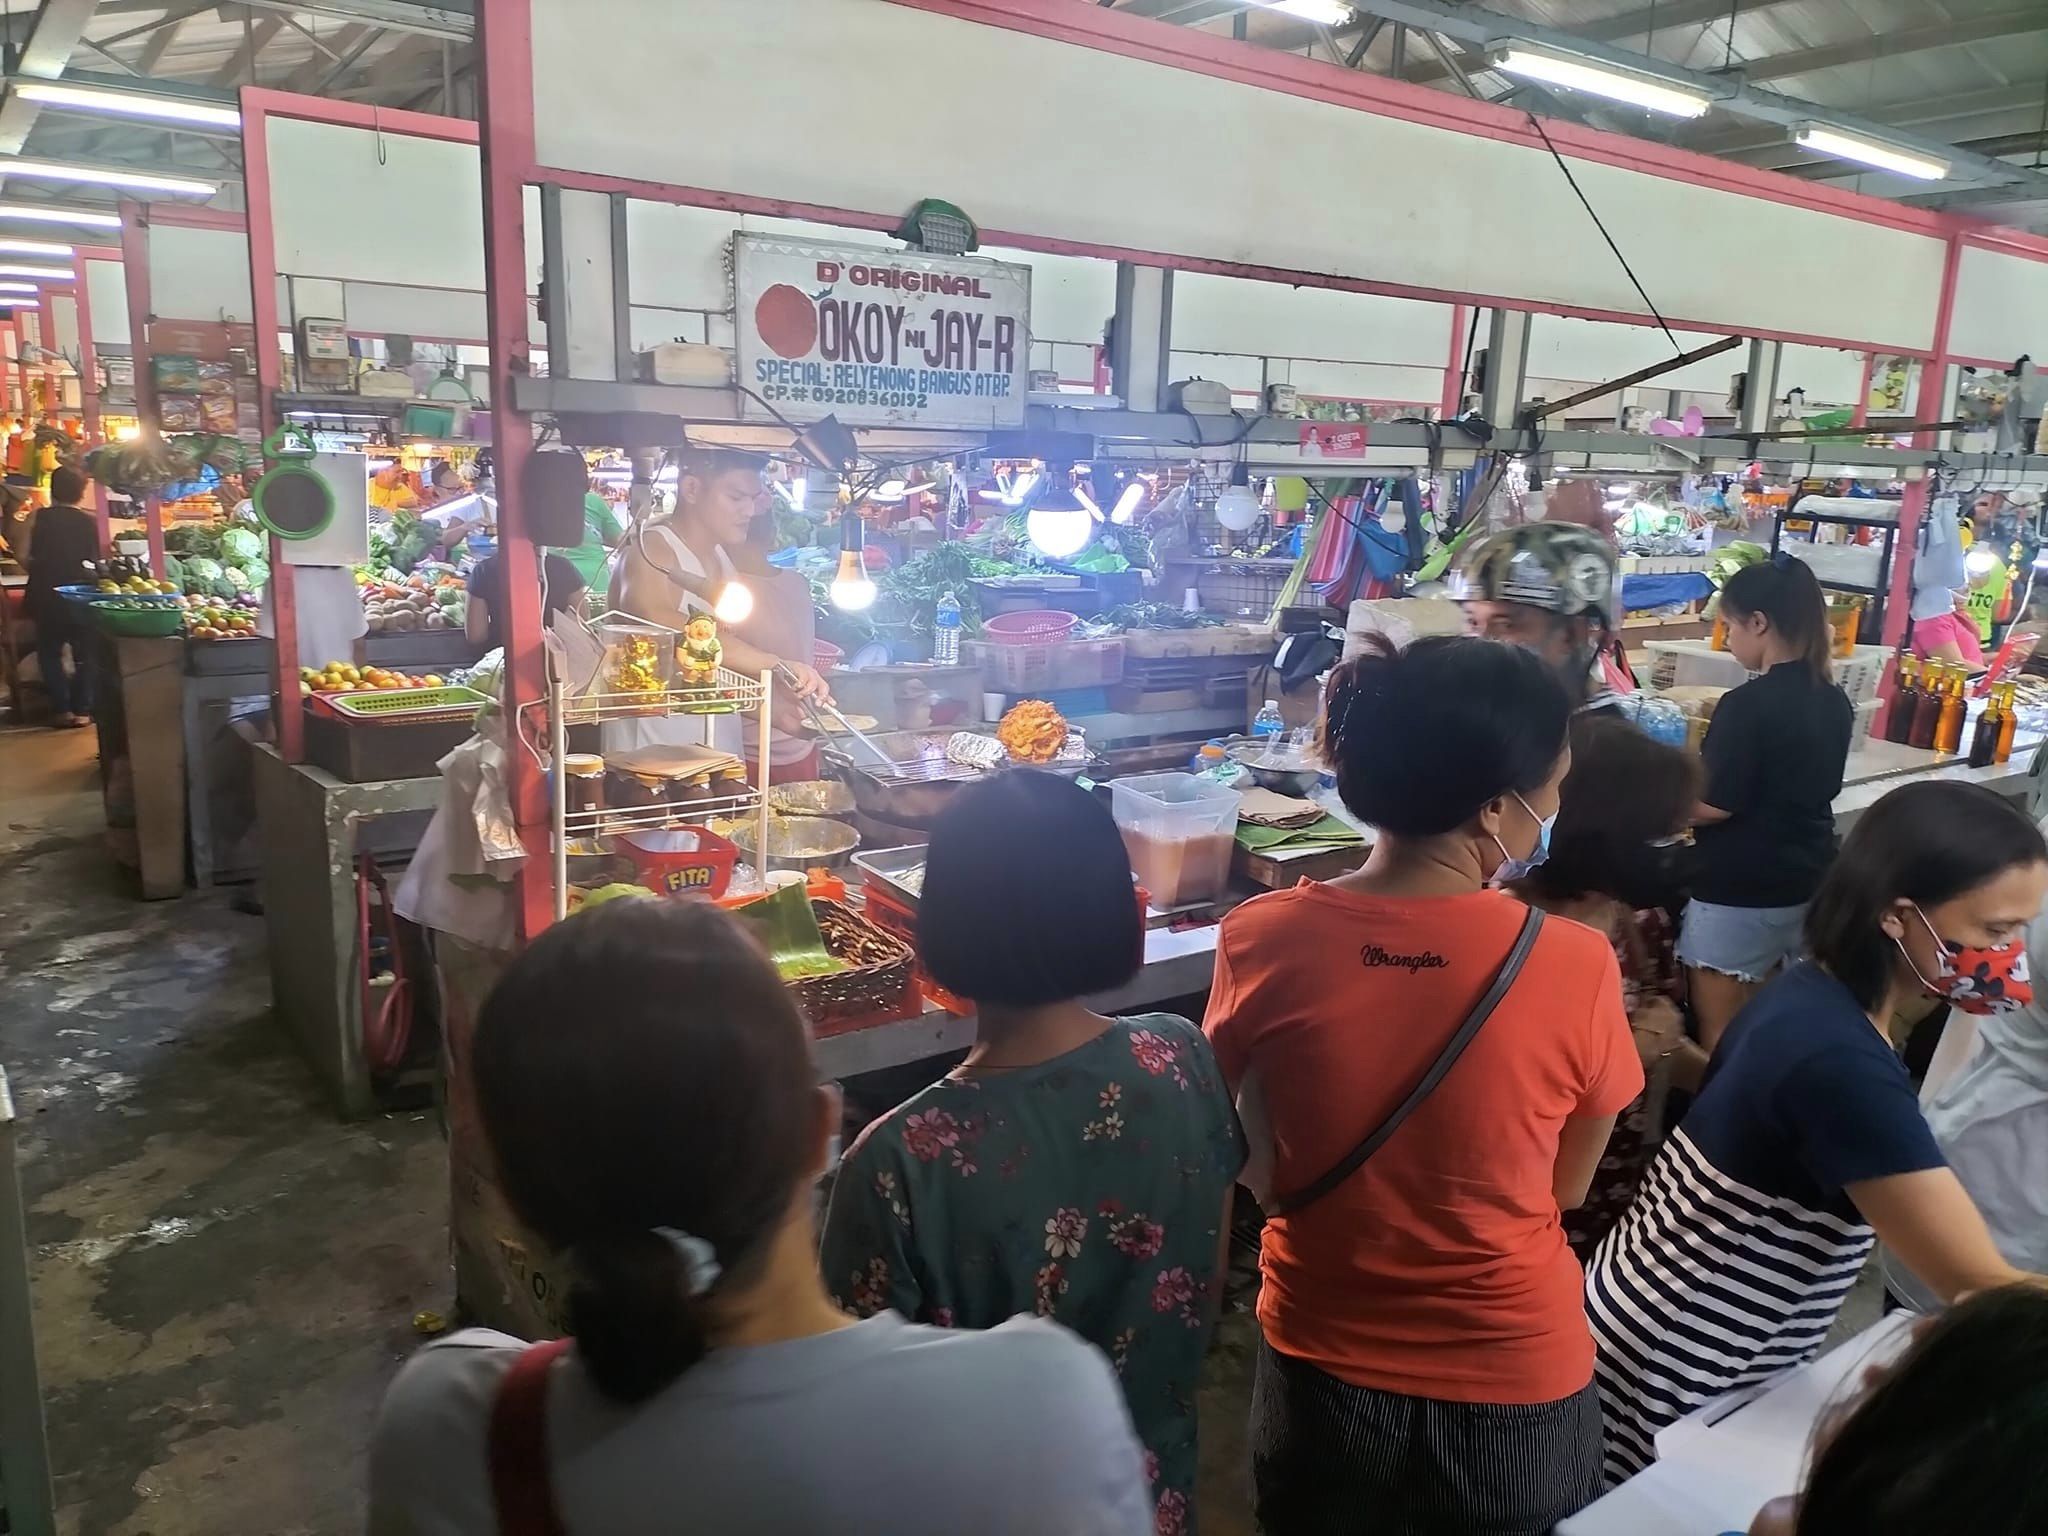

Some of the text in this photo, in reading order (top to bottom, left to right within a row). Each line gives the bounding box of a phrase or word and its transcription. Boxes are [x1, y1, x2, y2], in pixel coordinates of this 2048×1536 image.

[816, 261, 991, 299] D'ORIGINAL
[819, 298, 1015, 373] OKOY NI JAY-R
[756, 358, 1010, 397] SPECIAL: RELYENONG BANGUS ATBP.
[812, 388, 927, 408] 09208360192
[667, 867, 710, 891] FITA
[1360, 944, 1450, 975] Wrangler
